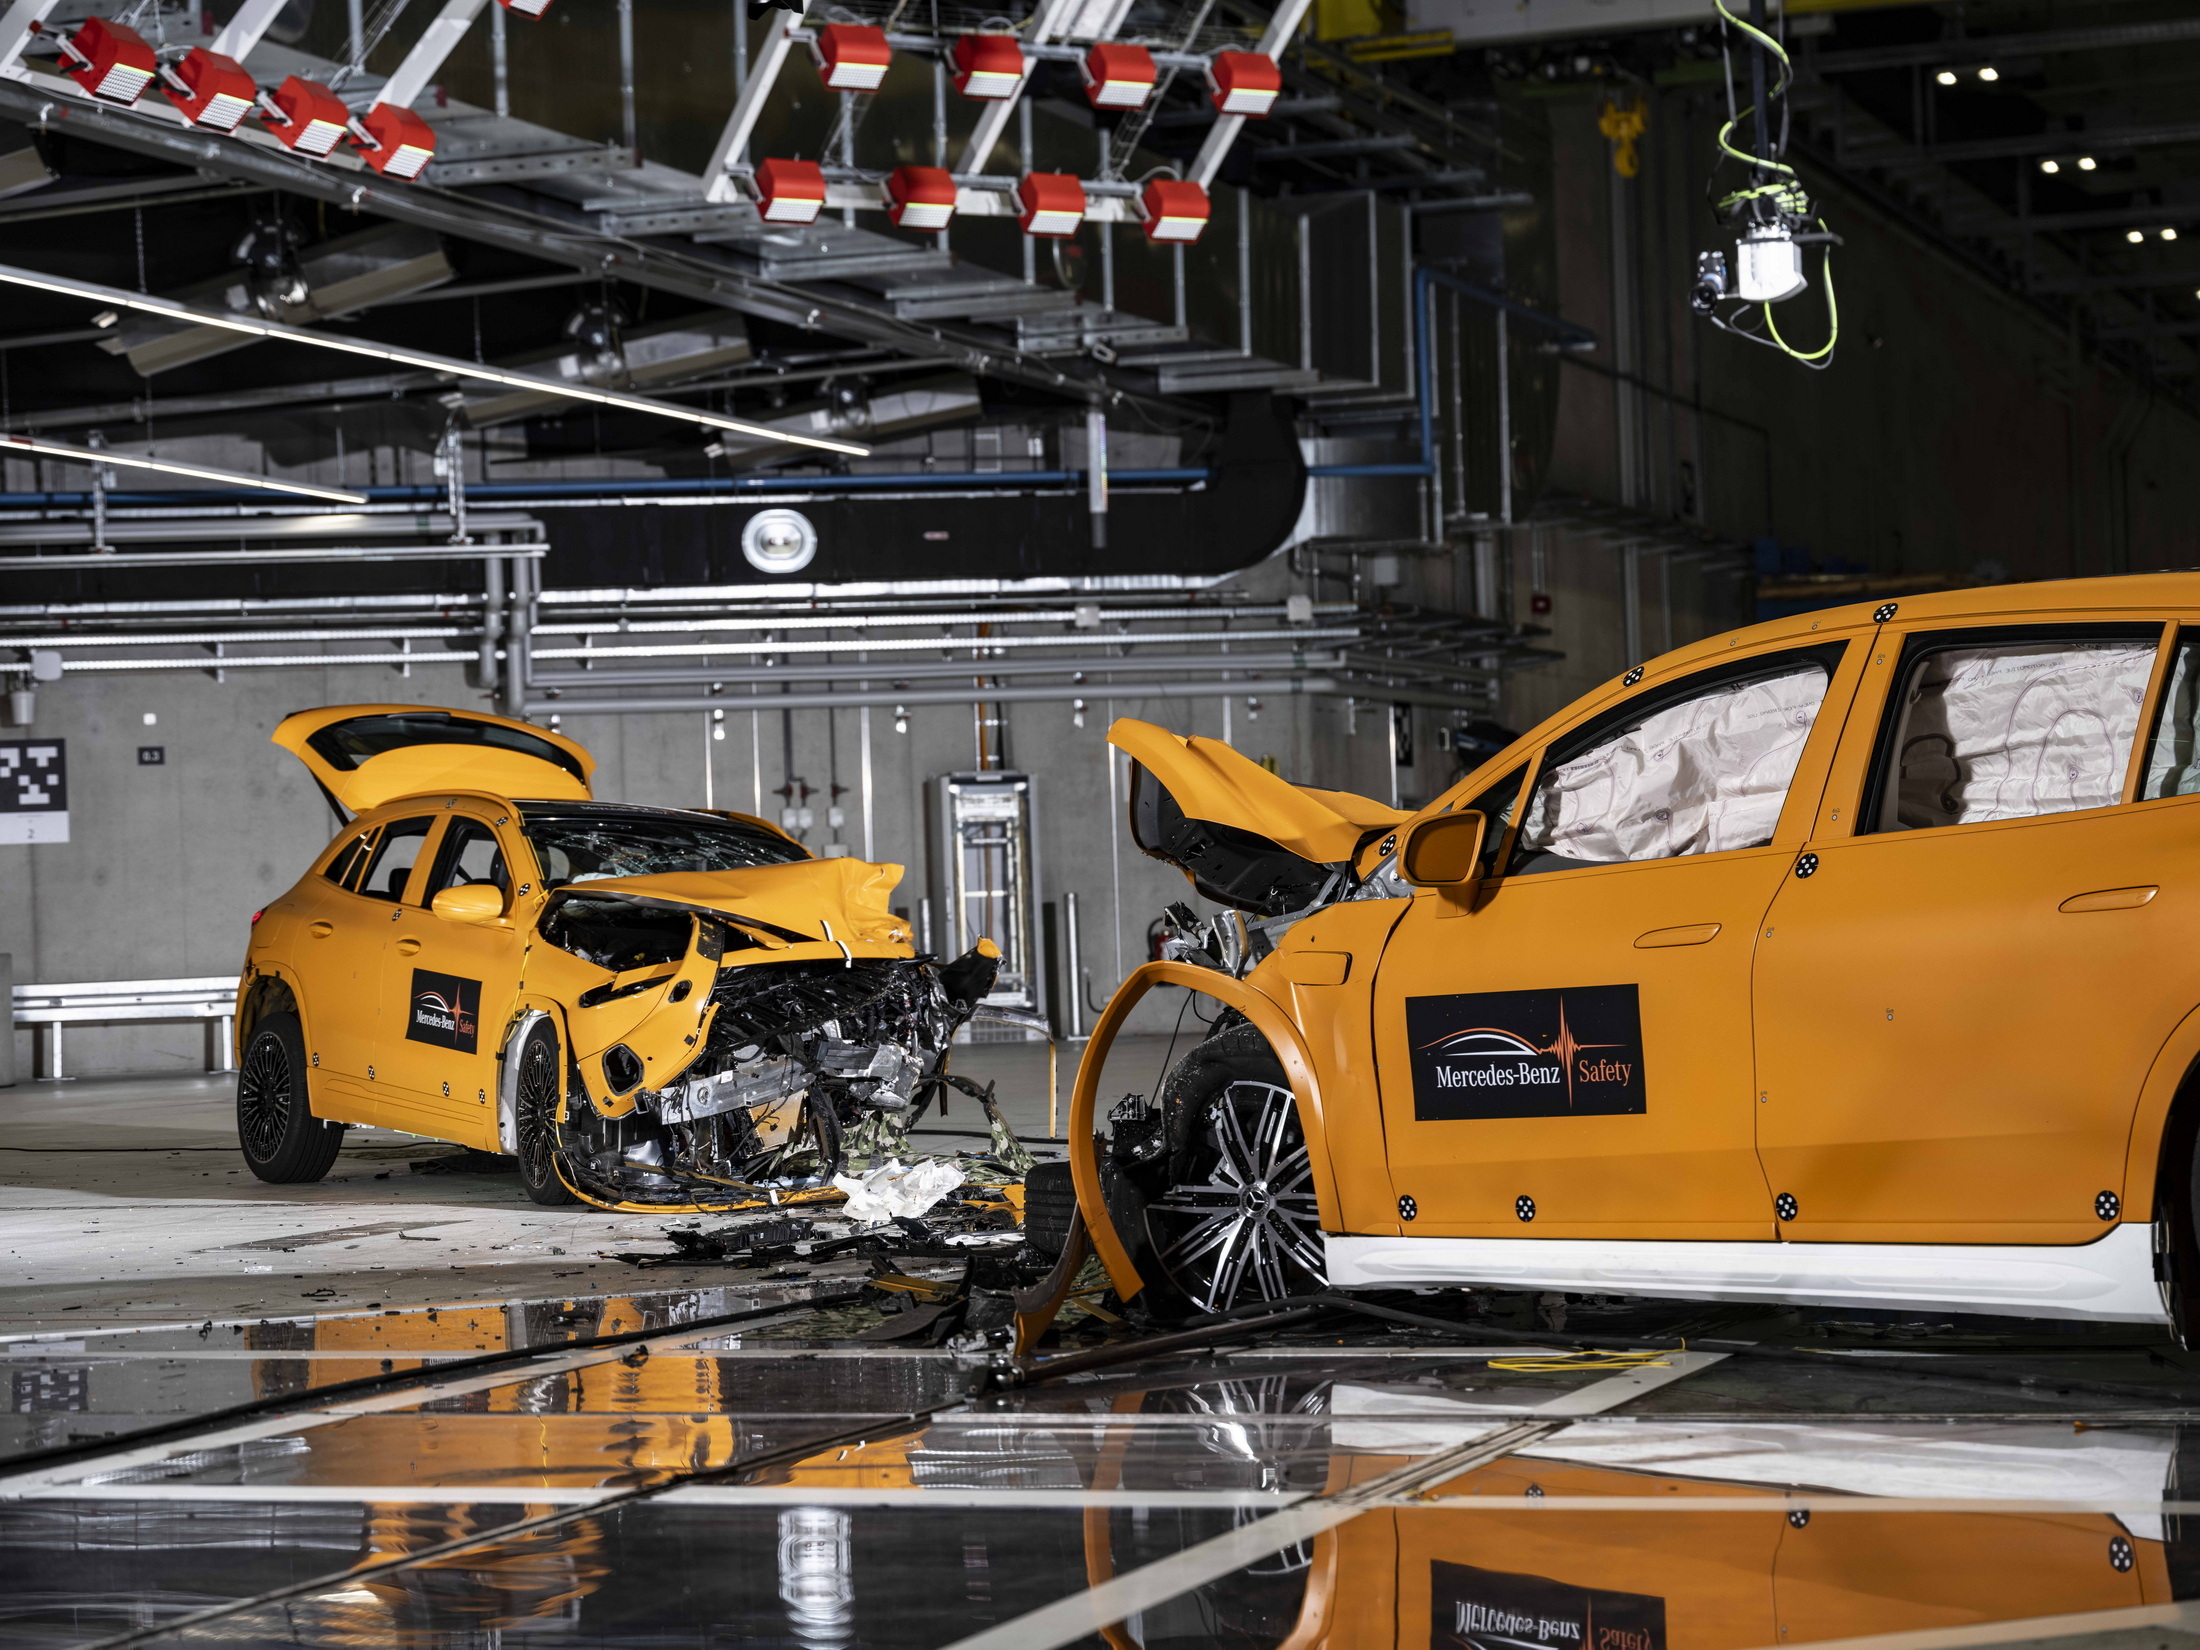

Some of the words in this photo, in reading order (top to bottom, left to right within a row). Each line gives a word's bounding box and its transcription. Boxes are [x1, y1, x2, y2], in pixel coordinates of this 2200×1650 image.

[416, 1010, 455, 1031] Mercedes-Benz
[459, 1019, 475, 1038] Safety
[1436, 1062, 1561, 1088] Mercedes-Benz
[1579, 1058, 1632, 1087] Safety
